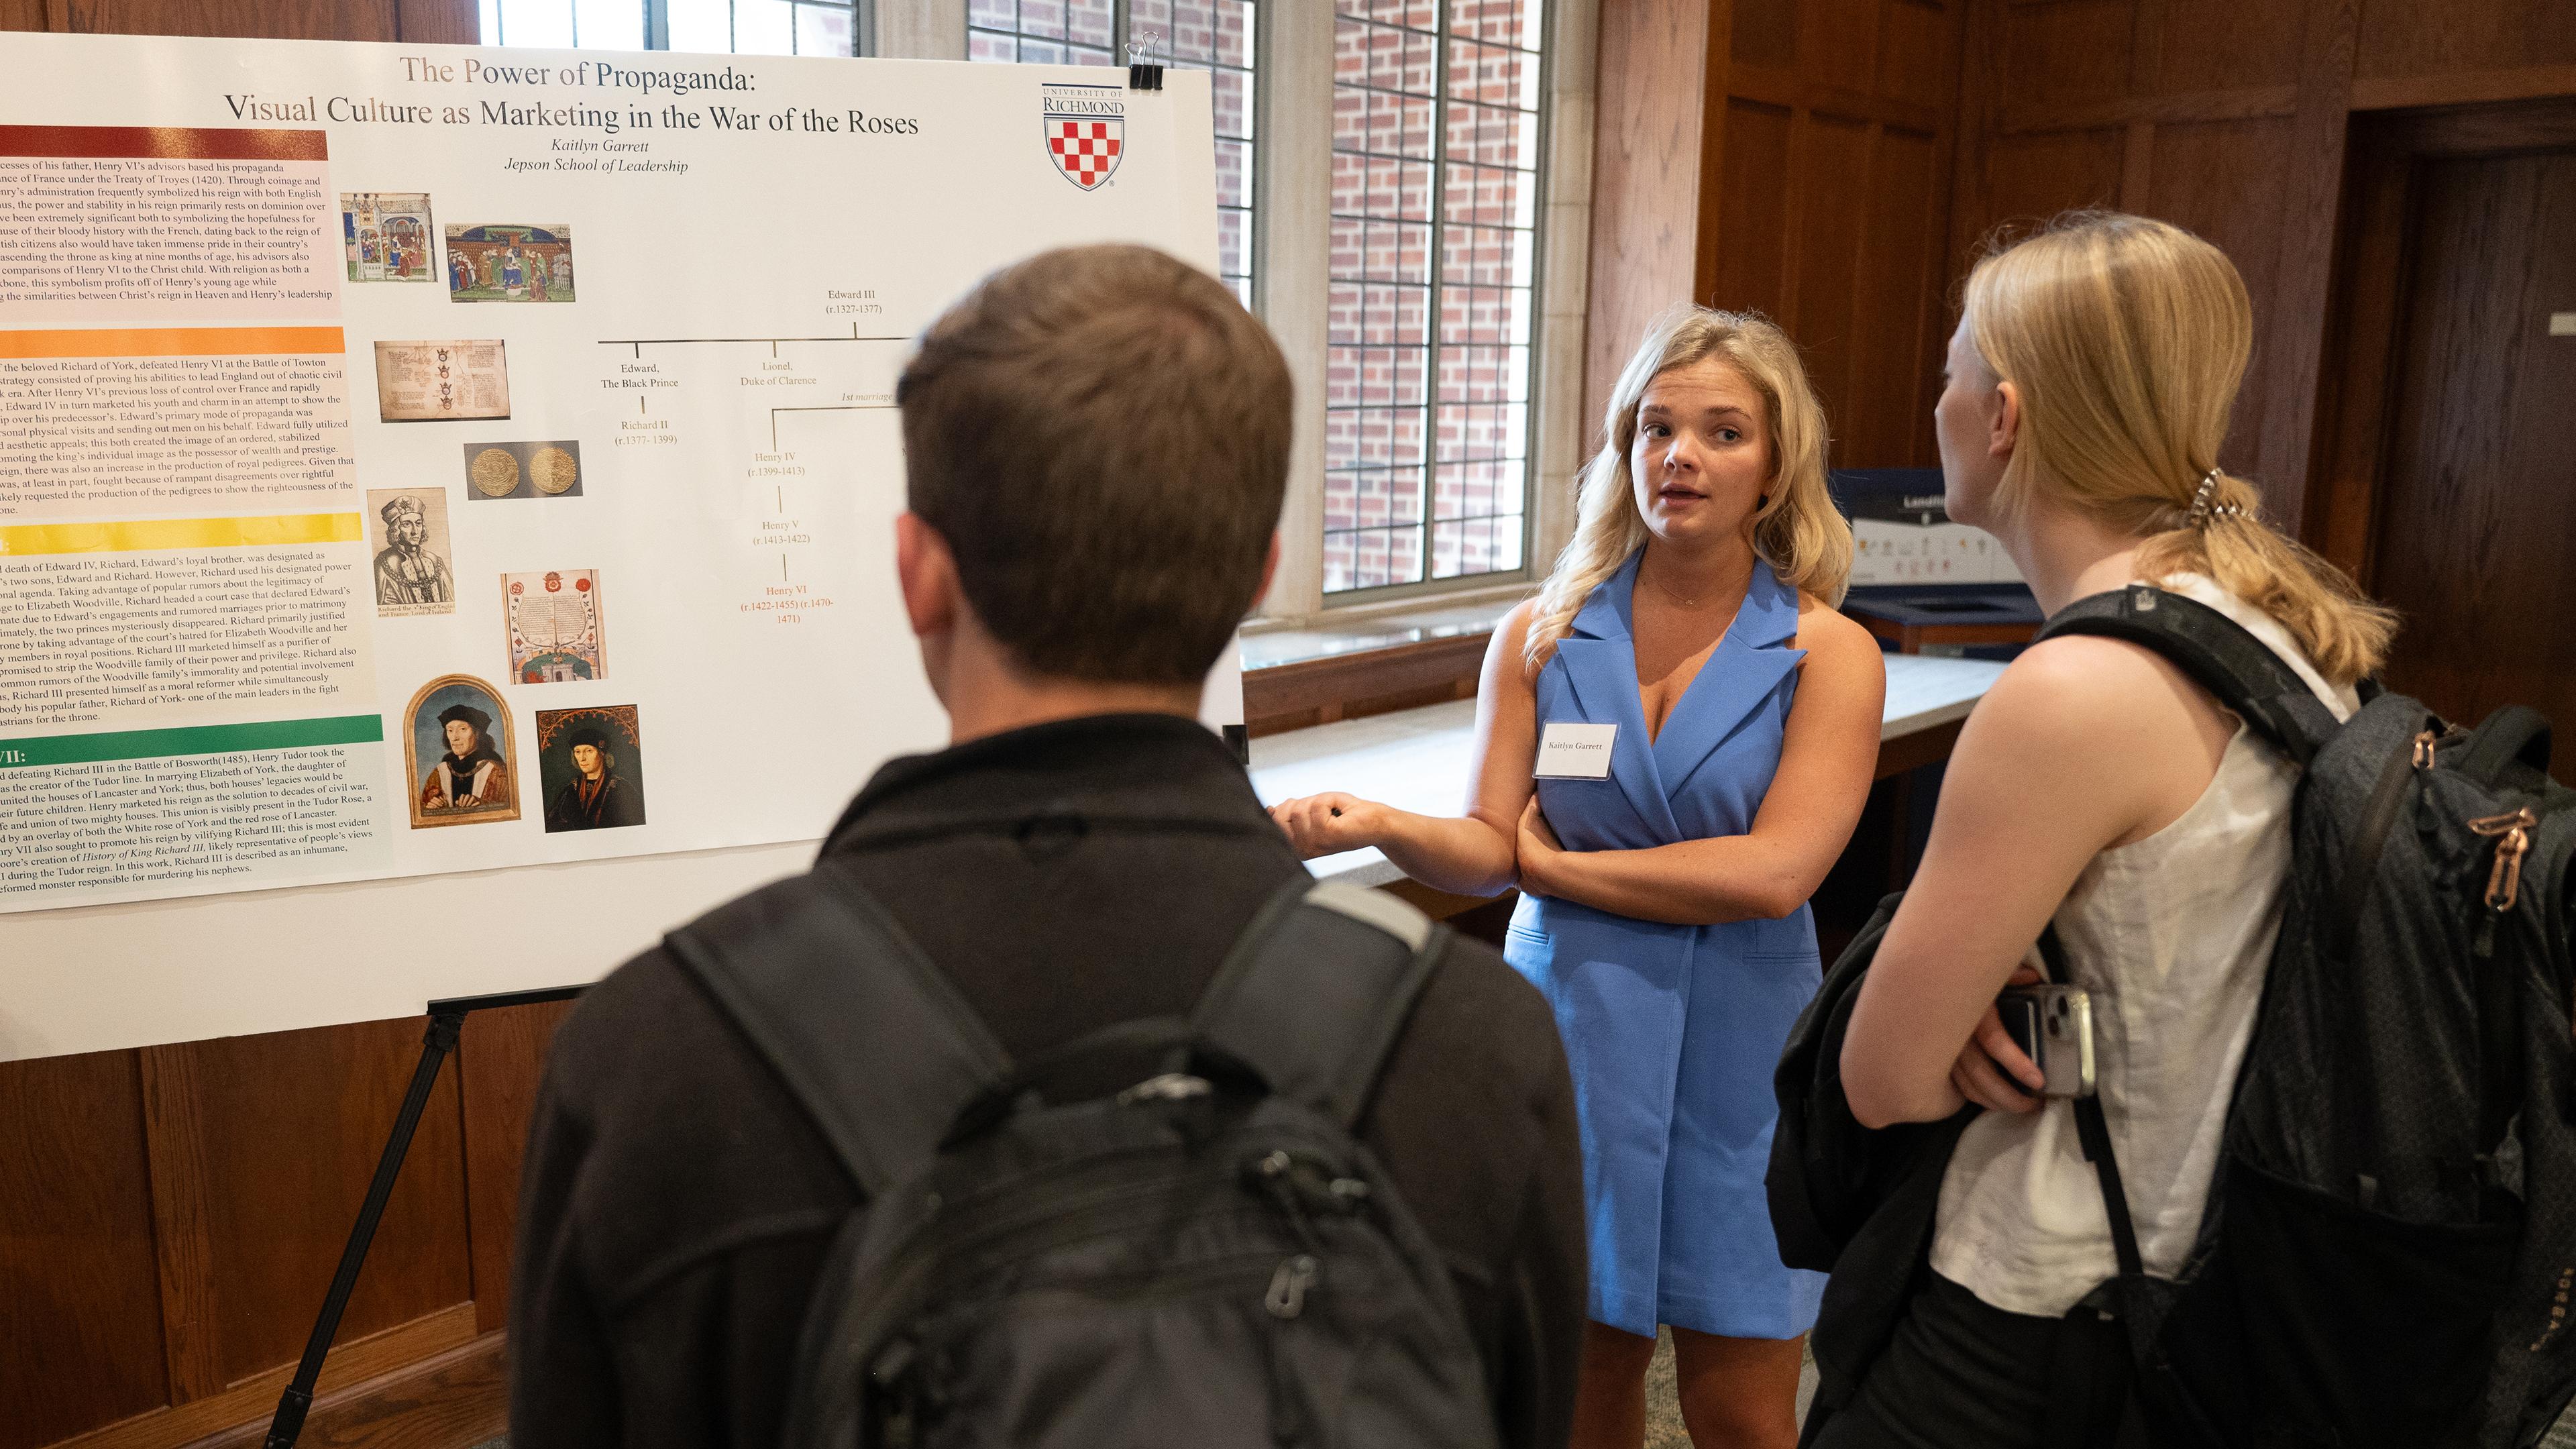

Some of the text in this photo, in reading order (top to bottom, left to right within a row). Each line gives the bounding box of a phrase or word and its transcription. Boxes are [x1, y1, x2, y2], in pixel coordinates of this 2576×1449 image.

[400, 57, 755, 95] The Power of Propaganda:
[1044, 89, 1106, 97] UNIVERSITY
[1043, 97, 1124, 114] RICHMOND
[224, 95, 918, 134] Visual Culture as Marketing in the War of the Roses
[551, 139, 648, 154] Kaitlyn Garrett
[504, 158, 688, 174] Jepson School of Leadership
[1, 253, 47, 263] ascending
[50, 253, 64, 261] the
[67, 252, 97, 261] throne
[111, 252, 132, 263] king
[146, 252, 165, 260] nine
[168, 252, 201, 260] months
[204, 252, 214, 260] of
[216, 255, 234, 263] age,
[237, 252, 250, 260] his
[253, 252, 289, 260] advisors
[292, 252, 309, 260] also
[7, 292, 21, 300] the
[24, 292, 76, 300] similarities
[78, 292, 117, 300] between
[119, 291, 155, 299] Christ's
[195, 290, 229, 299] Heaven
[232, 290, 248, 299] and
[250, 290, 285, 300] Henry's
[288, 290, 332, 300] leadership
[828, 290, 875, 299] Edward III
[826, 305, 881, 314] (r.1327-1377)
[4, 364, 19, 372] the
[21, 363, 58, 372] beloved
[61, 362, 97, 370] Richard
[101, 362, 111, 371] of
[113, 362, 138, 372] York,
[140, 361, 178, 369] defeated
[181, 360, 209, 371] Henry
[211, 359, 223, 368] VI
[236, 360, 250, 368] the
[282, 358, 292, 368] of
[293, 358, 326, 368] Towton
[621, 364, 659, 372] Edward,
[763, 362, 793, 370] Lionel,
[601, 380, 619, 388] The
[623, 379, 647, 387] Black
[741, 376, 816, 386] Duke of Clarence
[843, 392, 893, 402] 1st marriage
[622, 421, 667, 429] Richard II
[615, 435, 677, 447] (r.1377- 1399)
[755, 452, 796, 463] Henry IV
[748, 467, 805, 478] (r.1399-1413)
[763, 521, 789, 531] Henry
[753, 535, 810, 545] (r.1413-1422)
[5, 564, 30, 573] death
[33, 564, 44, 572] of
[46, 562, 80, 572] Edward
[85, 561, 97, 570] IV,
[101, 559, 138, 569] Richard,
[142, 557, 183, 567] Edward's
[186, 556, 208, 566] loyal
[211, 555, 245, 564] brother,
[267, 551, 313, 563] designated
[766, 587, 793, 596] Henry
[741, 598, 833, 612] (r.1422-1455) (r.1470-
[778, 614, 800, 623] 1471)
[13, 690, 49, 700] Richard
[52, 689, 62, 698] III
[66, 686, 109, 699] presented
[111, 684, 147, 694] himself
[168, 681, 194, 690] moral
[197, 680, 235, 688] reformer
[237, 678, 262, 686] while
[264, 673, 329, 684] simultaneously
[1549, 742, 1573, 751] Kaitlyn
[13, 784, 27, 792] the
[30, 782, 62, 791] creator
[64, 780, 74, 788] of
[76, 779, 91, 787] the
[92, 777, 120, 786] Tudor
[123, 775, 142, 784] line.
[145, 774, 154, 782] In
[157, 771, 198, 782] marrying
[201, 767, 241, 777] Elizabeth
[244, 766, 254, 775] of
[255, 765, 278, 773] York,
[297, 761, 335, 771] daughter
[31, 855, 67, 865] creation
[70, 853, 80, 862] of
[83, 853, 116, 861] History
[119, 849, 129, 860] of
[131, 849, 152, 858] King
[155, 845, 190, 857] Richard
[193, 843, 205, 852] III,
[209, 841, 233, 851] likely
[236, 838, 297, 850] representative
[299, 835, 309, 843] of
[311, 832, 345, 844] people's
[39, 866, 252, 890] monster responsible for murdering his nephews.
